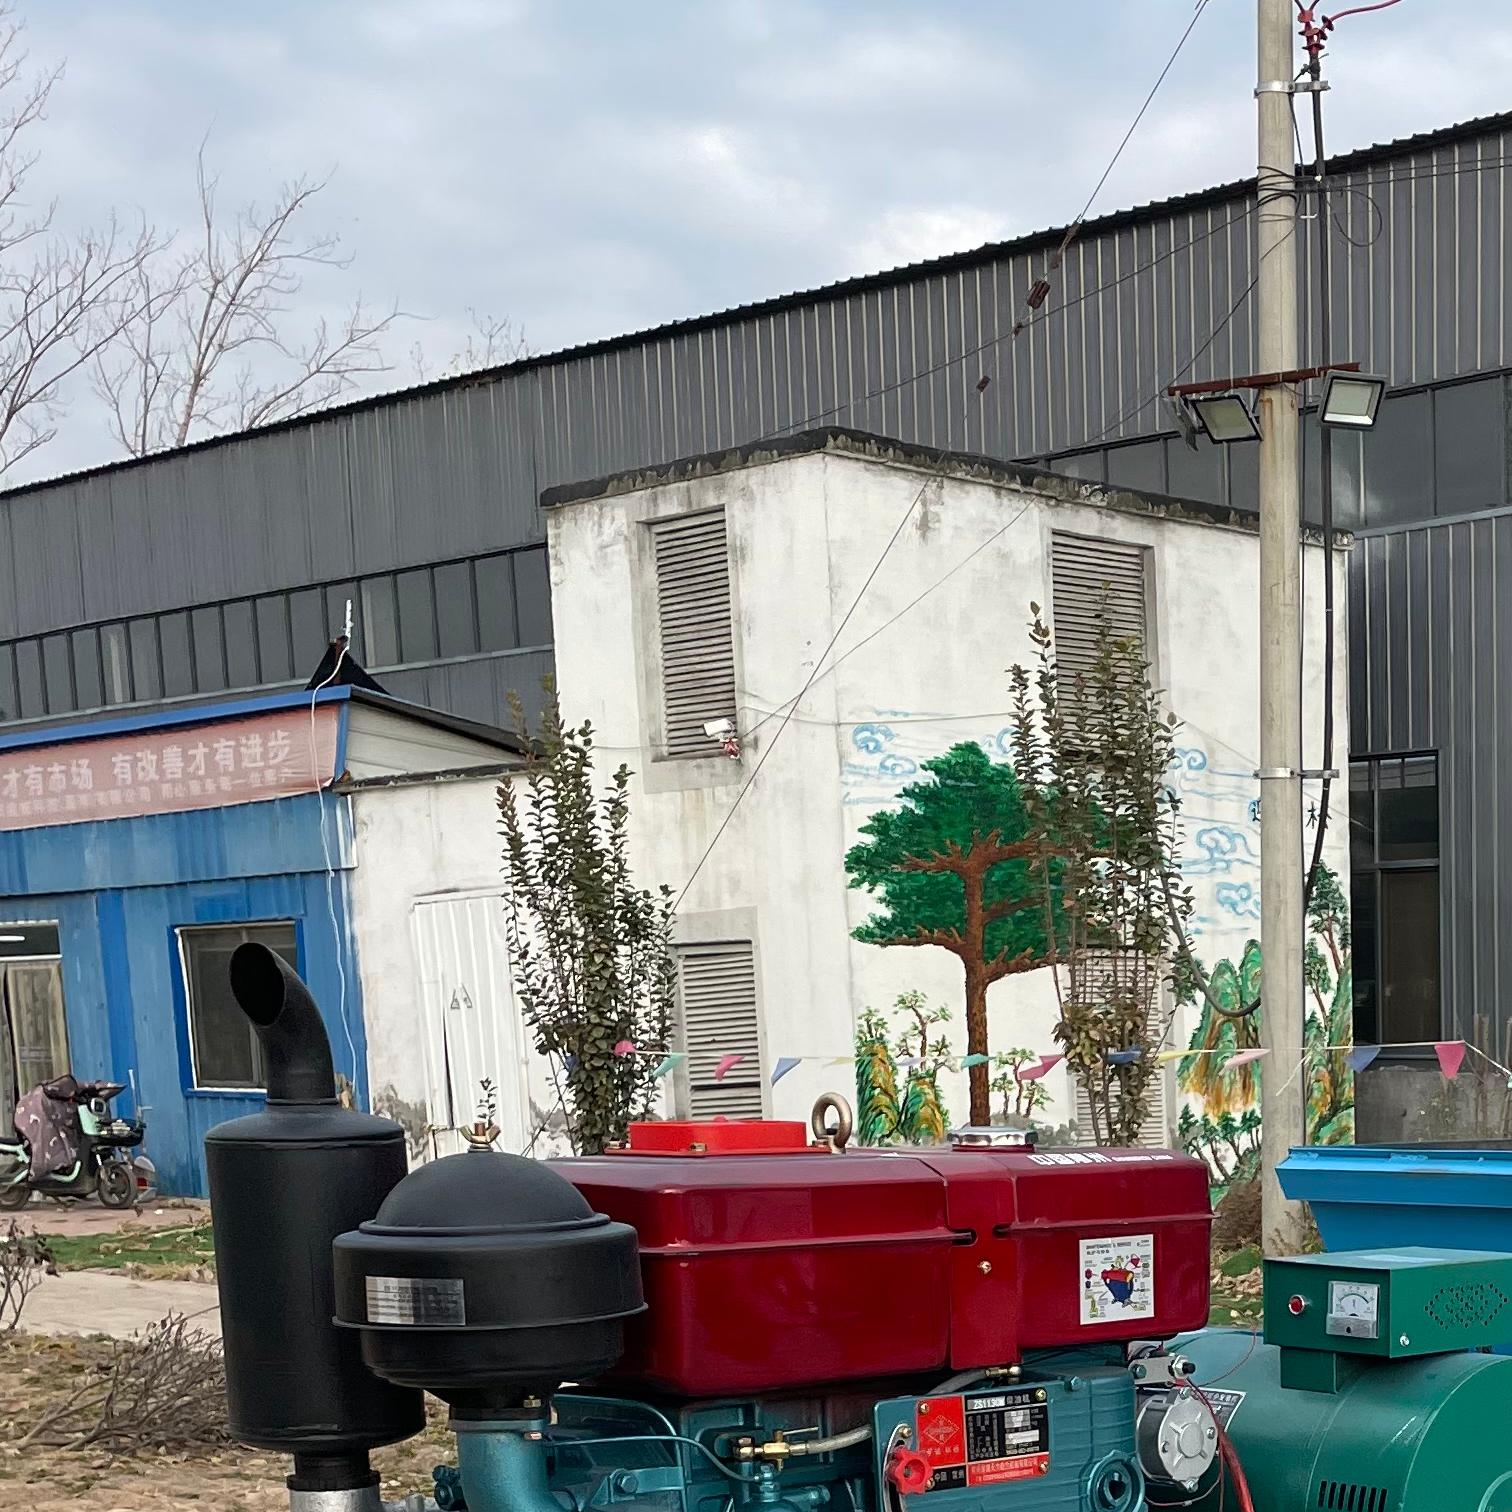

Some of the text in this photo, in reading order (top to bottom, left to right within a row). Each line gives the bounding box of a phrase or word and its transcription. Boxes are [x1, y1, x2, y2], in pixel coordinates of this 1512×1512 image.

[3, 730, 291, 800] 才有市场 有改善才有进步
